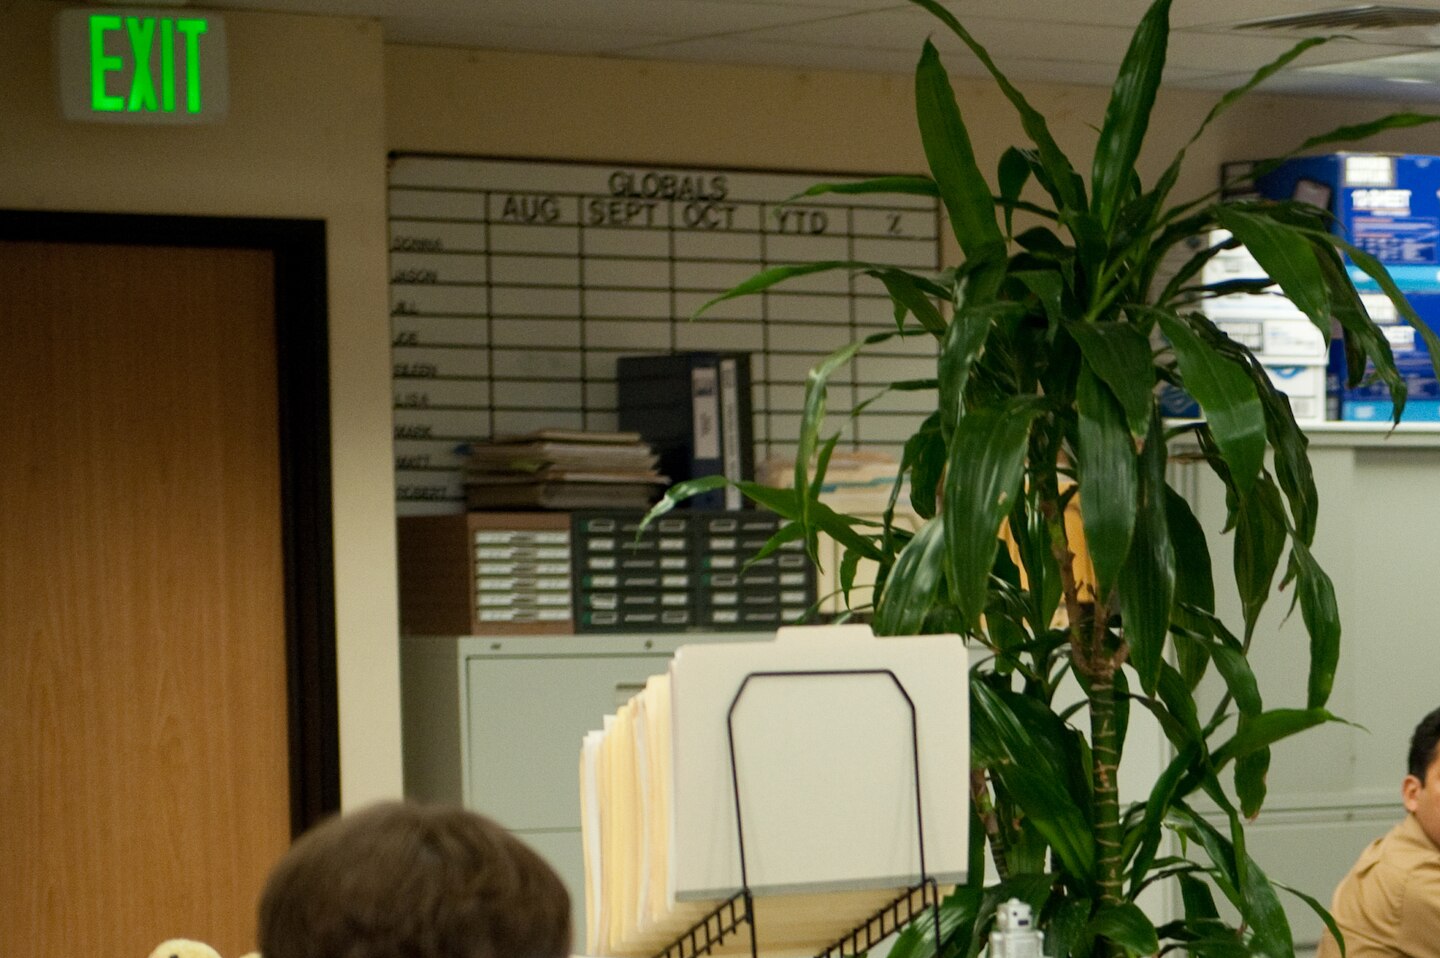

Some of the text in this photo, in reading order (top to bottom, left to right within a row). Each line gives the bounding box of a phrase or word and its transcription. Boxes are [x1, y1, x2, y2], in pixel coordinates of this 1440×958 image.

[88, 14, 208, 114] EXIT
[607, 171, 729, 201] GLOBALS
[502, 195, 561, 223] AUG
[587, 199, 660, 228] SEPT
[682, 201, 739, 229] OCT
[775, 208, 830, 235] YTD
